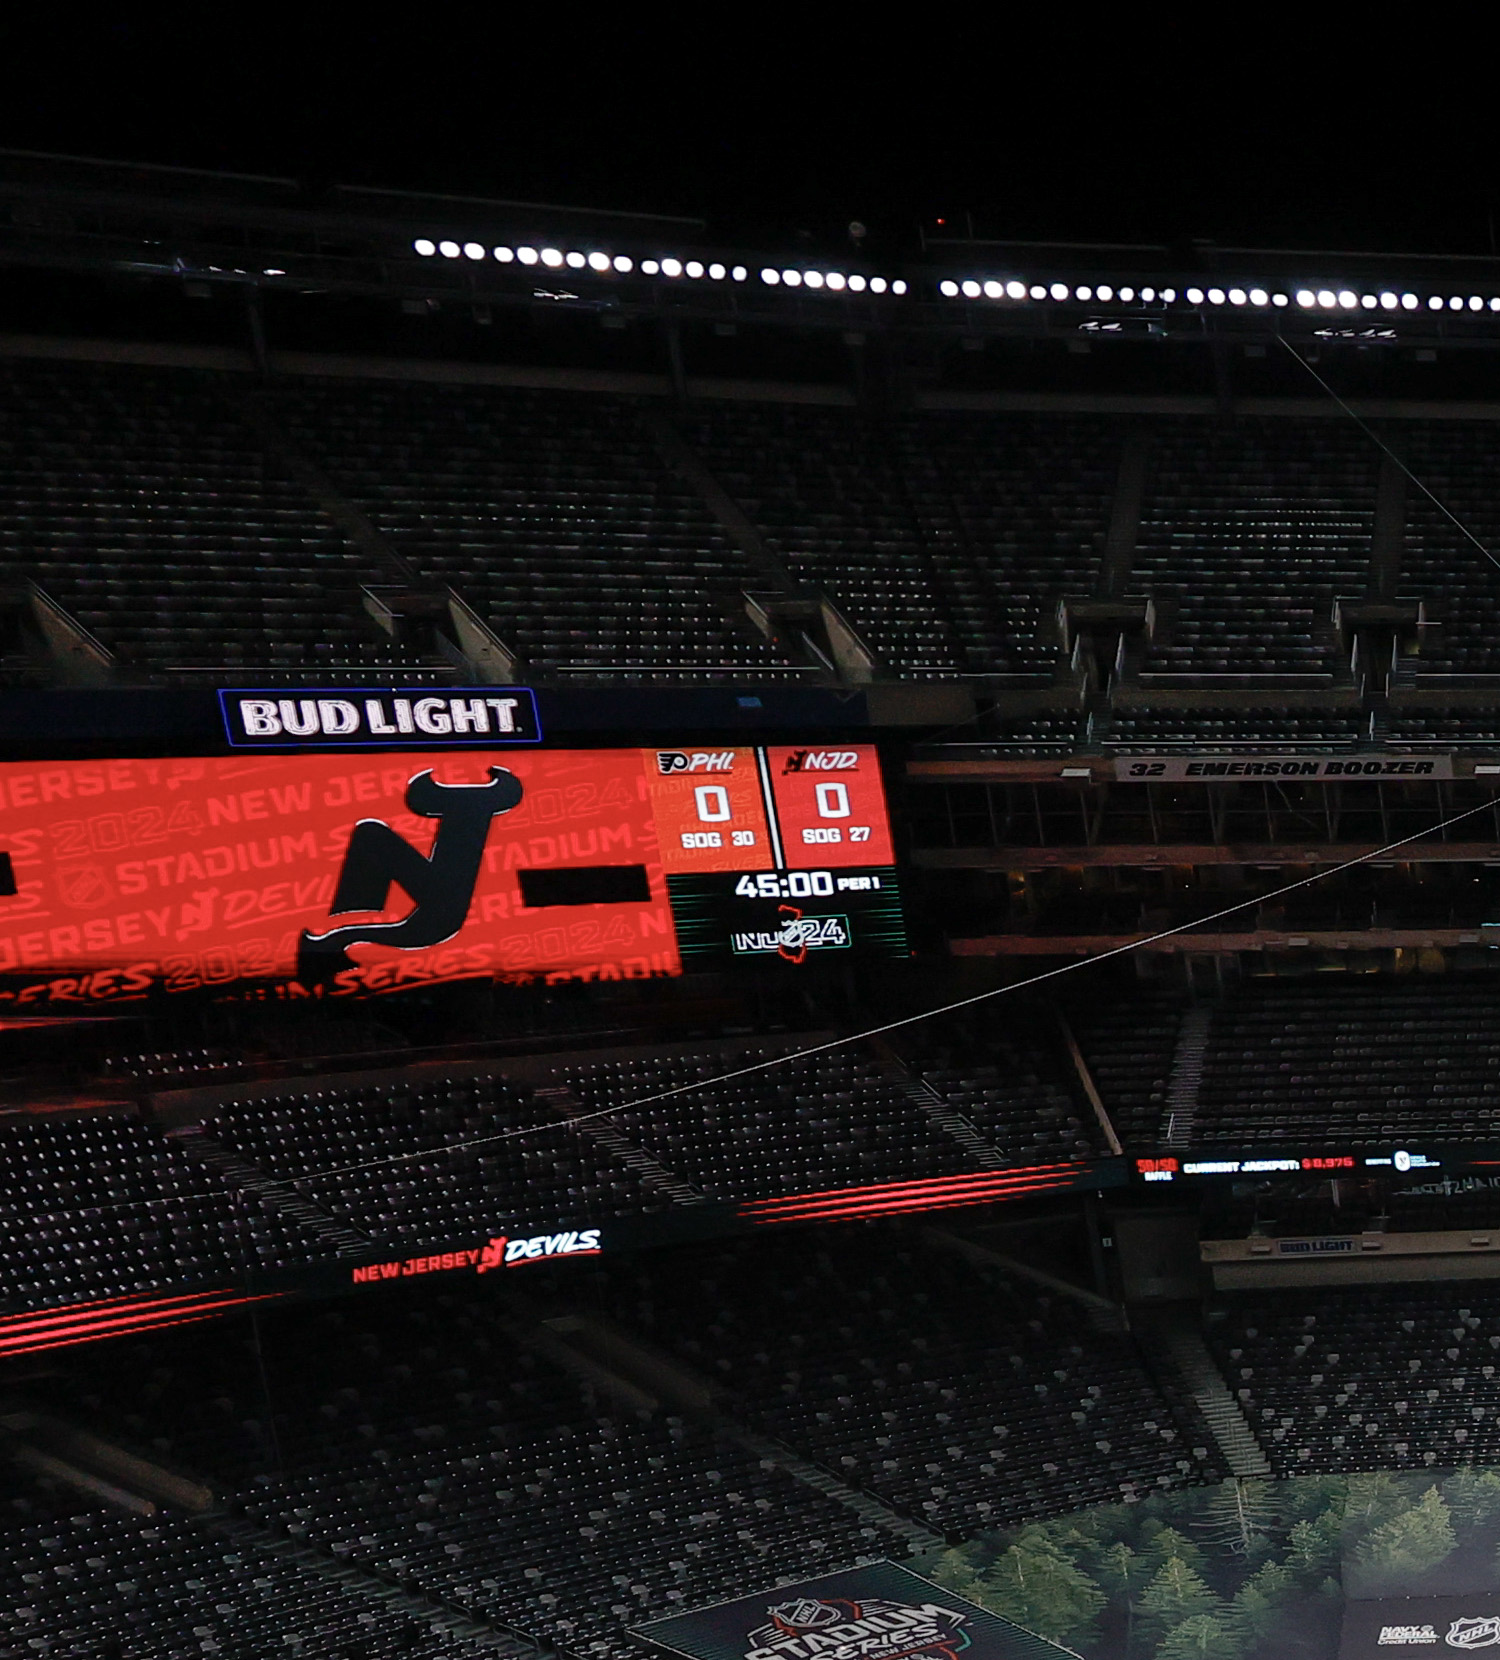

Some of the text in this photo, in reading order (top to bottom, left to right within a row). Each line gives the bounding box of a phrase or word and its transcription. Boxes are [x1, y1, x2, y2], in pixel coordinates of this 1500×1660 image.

[240, 697, 518, 736] BUD LIGHT
[689, 752, 733, 771] PHI
[804, 751, 857, 771] NJD
[1129, 760, 1435, 777] 32 EMERSON BOOZER
[693, 784, 732, 823] 0
[814, 781, 853, 819] 0
[681, 830, 755, 849] SOG 30
[802, 825, 872, 844] SOG 27
[734, 870, 836, 899] 45:00
[837, 876, 871, 892] PER
[353, 1229, 602, 1284] NEW JERSEY DEVILS
